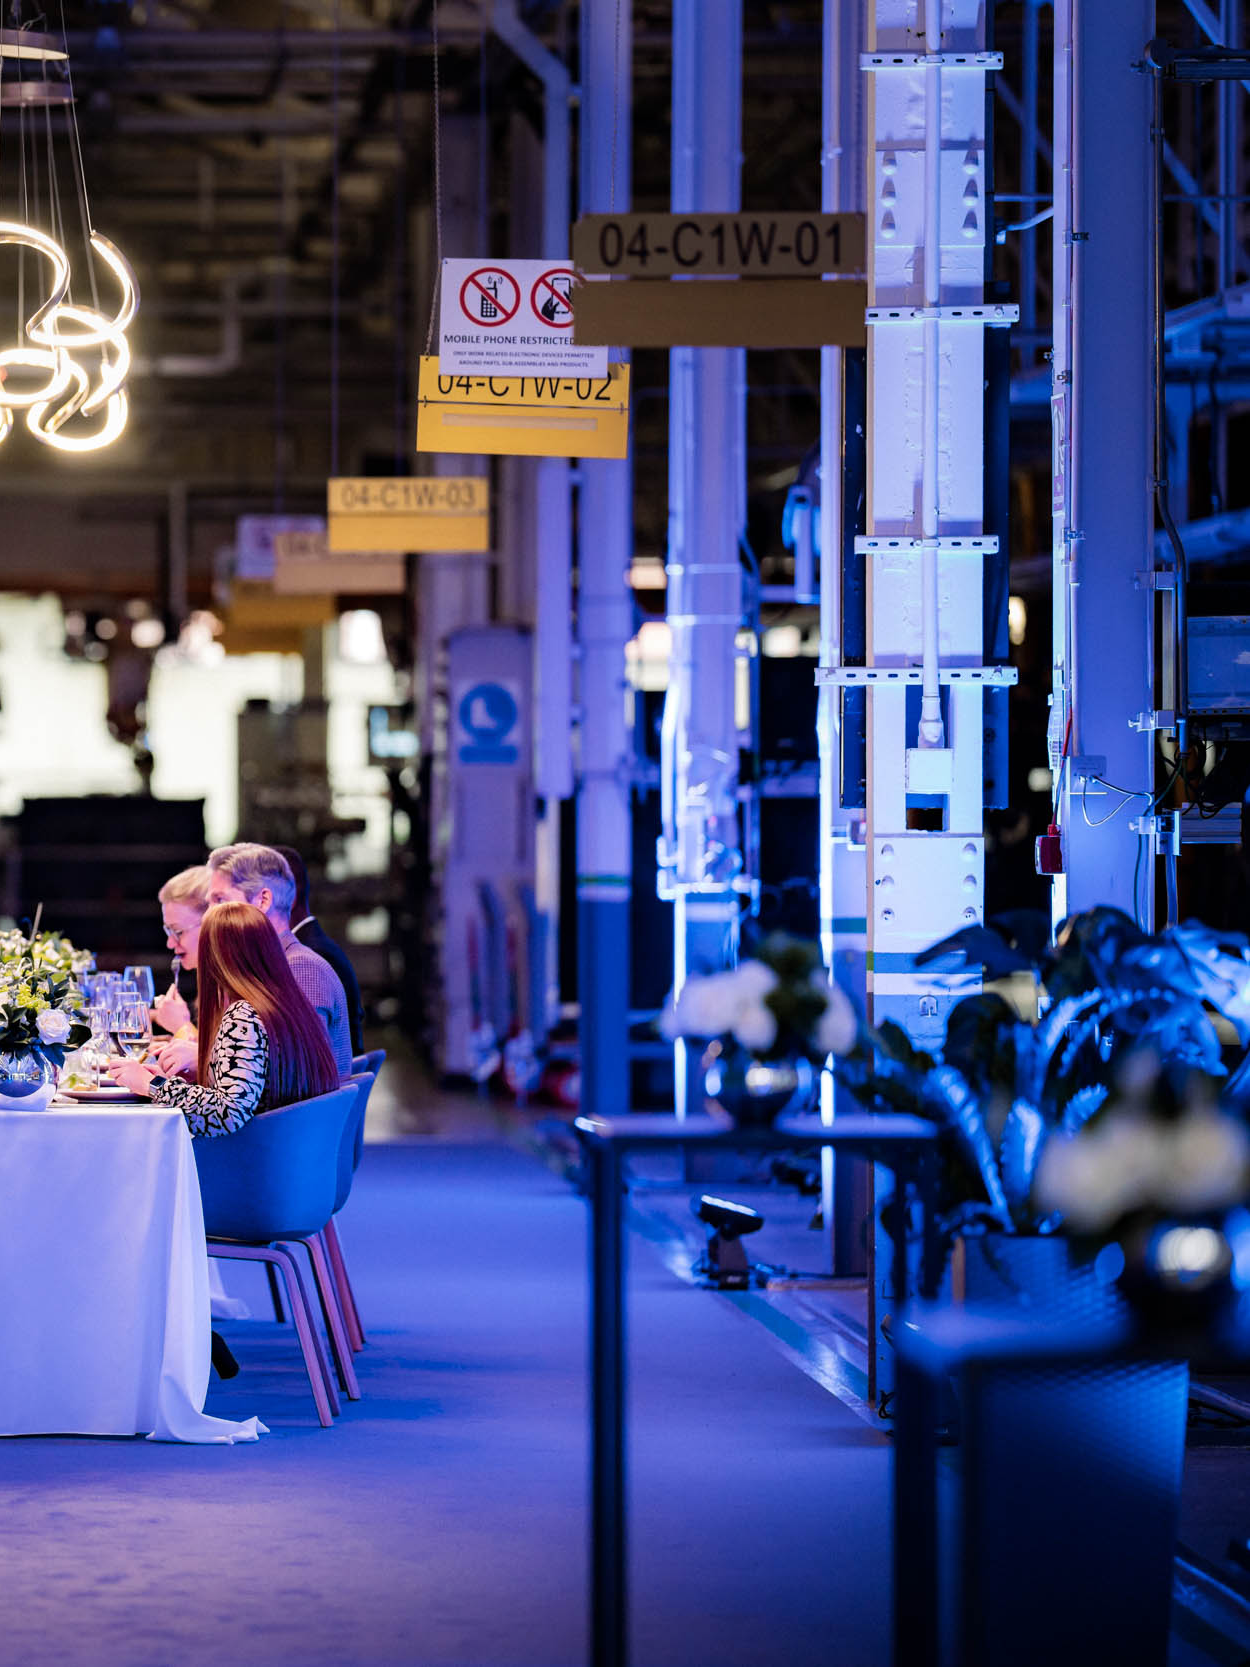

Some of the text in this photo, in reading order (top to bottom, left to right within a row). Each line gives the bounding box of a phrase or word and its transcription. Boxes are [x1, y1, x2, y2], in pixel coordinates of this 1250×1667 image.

[600, 221, 841, 267] 04-C1W-01
[443, 334, 481, 344] MOBILE
[484, 335, 517, 345] PHONE
[341, 481, 476, 509] 04-C1W-03
